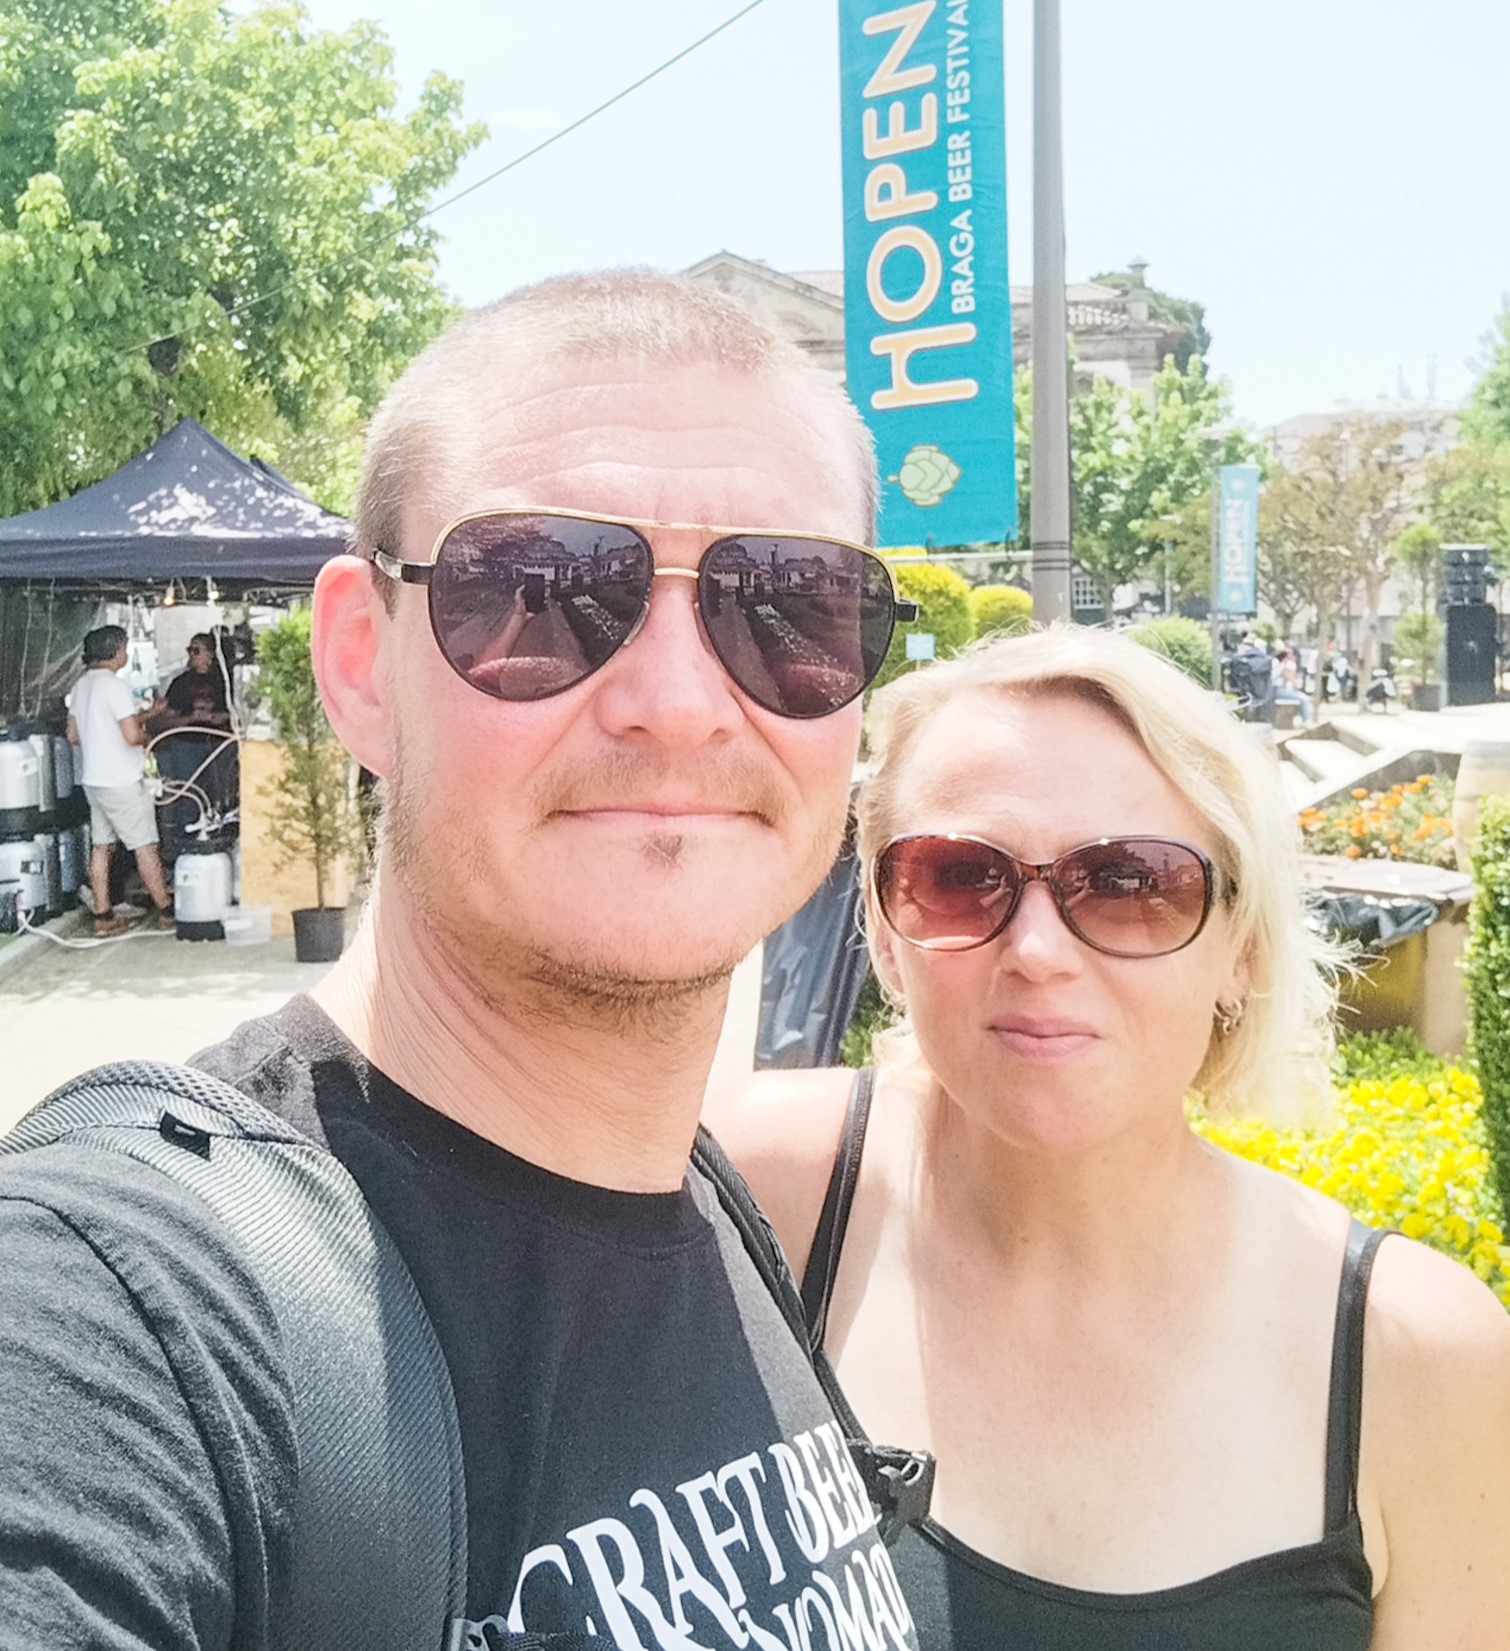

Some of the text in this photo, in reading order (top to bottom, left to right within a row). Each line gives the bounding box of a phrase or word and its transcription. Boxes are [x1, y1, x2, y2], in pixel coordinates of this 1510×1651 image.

[862, 0, 979, 410] HOPEN
[948, 131, 973, 202] BEER
[951, 209, 976, 315] BRAGA
[506, 1452, 787, 1651] CRAFT
